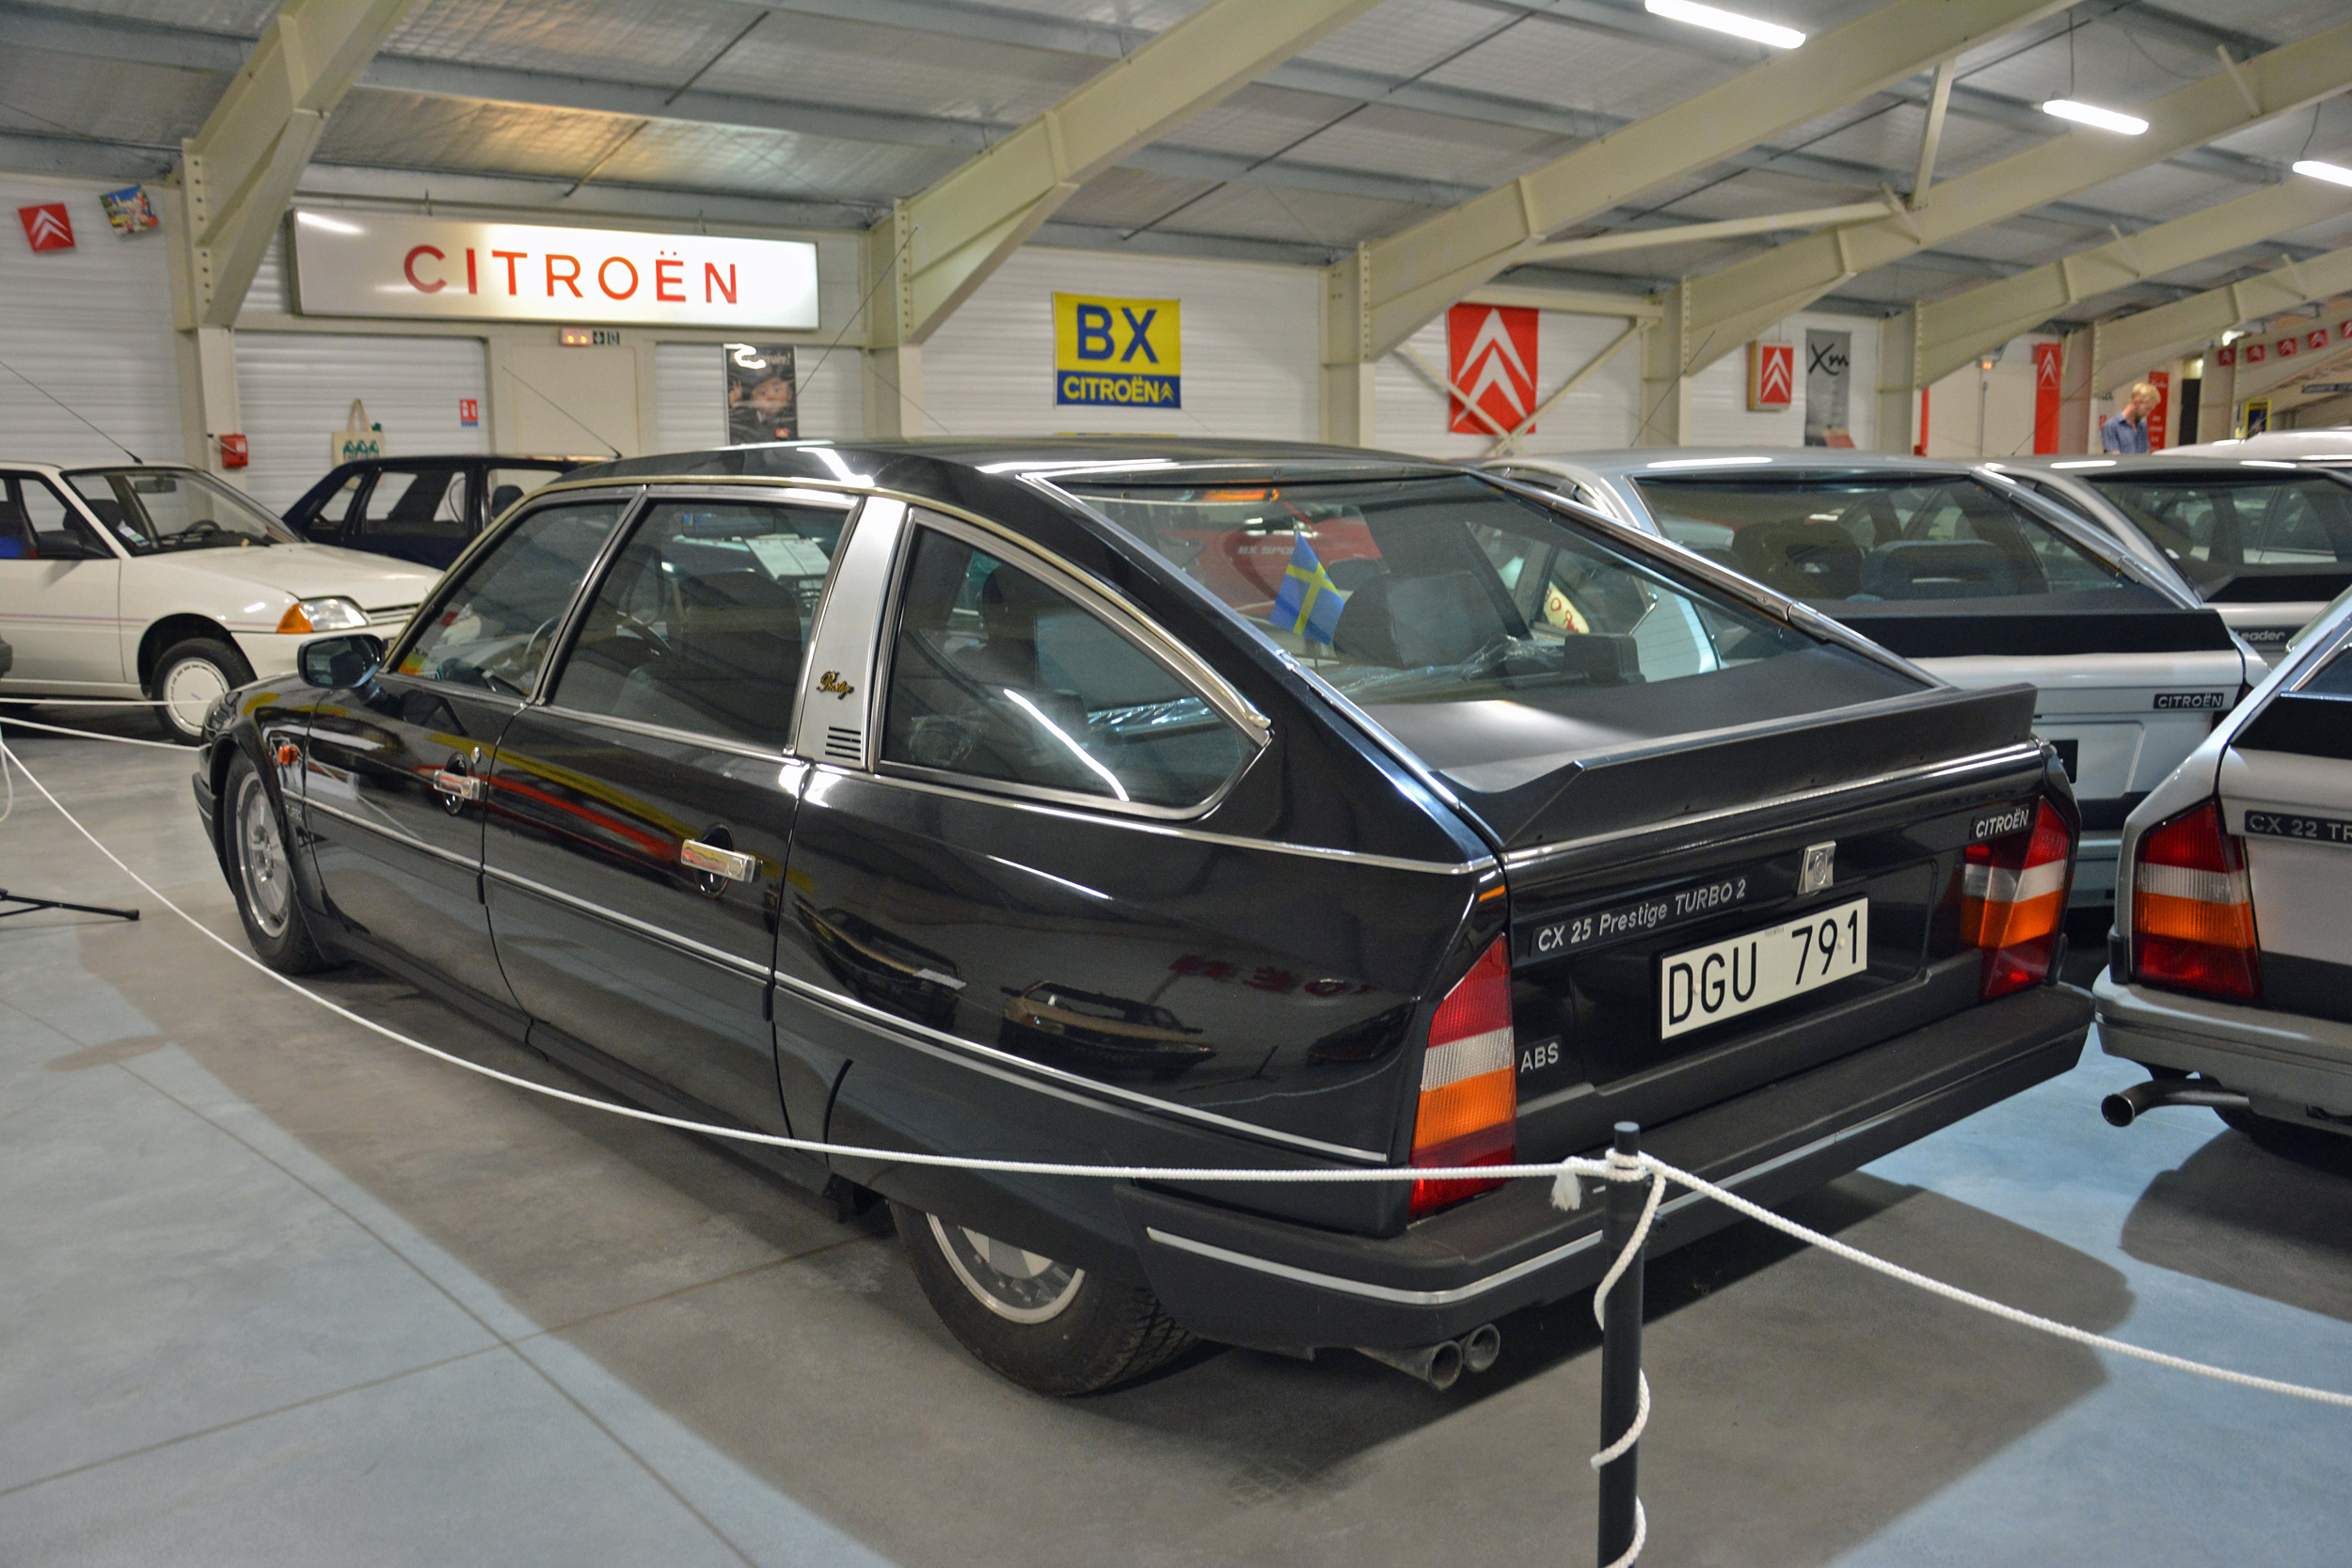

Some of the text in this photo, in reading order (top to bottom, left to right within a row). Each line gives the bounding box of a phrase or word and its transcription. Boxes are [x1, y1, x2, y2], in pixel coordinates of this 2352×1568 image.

[404, 244, 738, 305] CITROËN
[1076, 303, 1159, 364] BX
[1063, 375, 1160, 404] CITROËN
[2235, 630, 2285, 641] eader
[2157, 692, 2222, 707] CITROËN
[1976, 808, 2029, 838] CITROËN
[2249, 815, 2282, 834] CX
[2291, 818, 2318, 838] 22
[1537, 878, 1746, 952] CX 25 Prestige TURBO 2
[1668, 909, 1858, 1026] DGU 791
[1520, 1041, 1559, 1073] ABS
